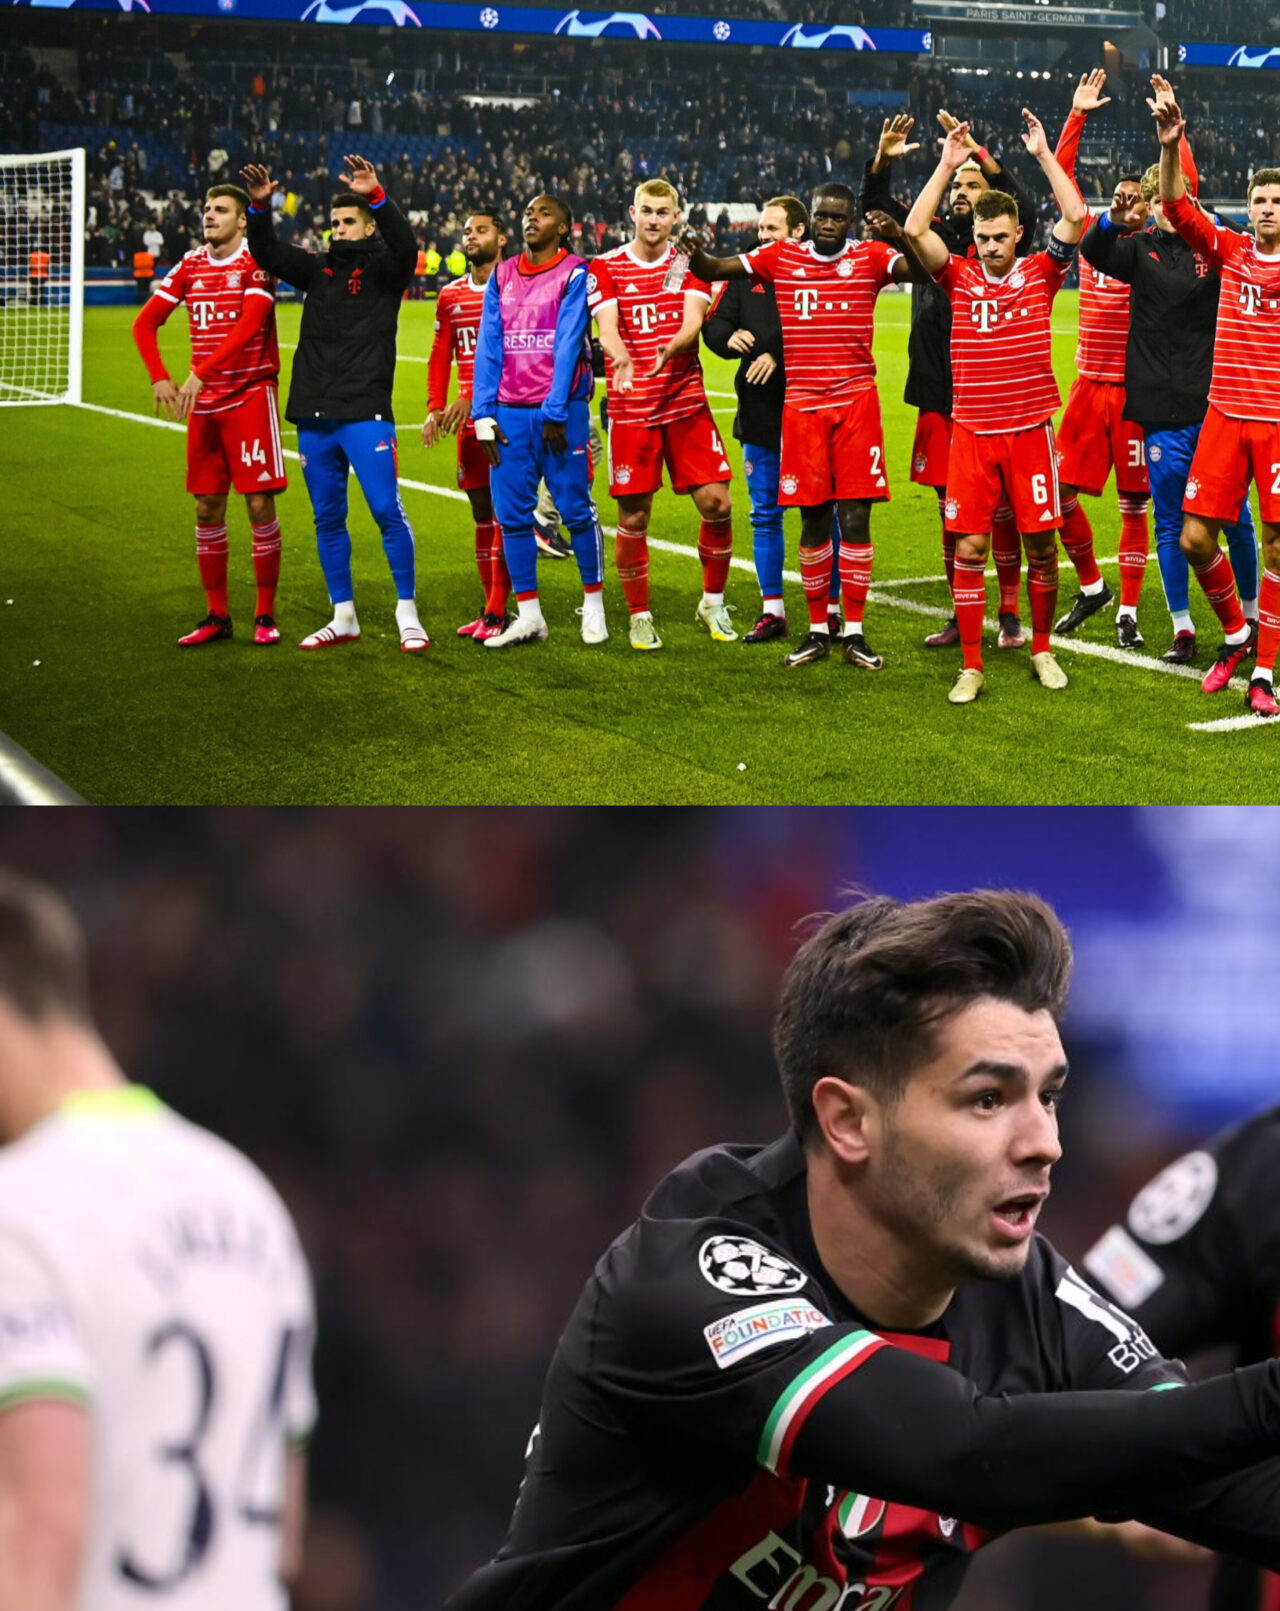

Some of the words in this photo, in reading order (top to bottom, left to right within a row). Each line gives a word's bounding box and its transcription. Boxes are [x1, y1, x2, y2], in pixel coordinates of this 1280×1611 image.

[966, 8, 999, 19] PARIS
[1001, 10, 1085, 23] SAINT-GERMAIN
[504, 334, 555, 349] RESPEC
[241, 438, 266, 468] 44
[712, 429, 724, 456] 4
[870, 446, 881, 475] 2
[1032, 473, 1048, 505] 6
[708, 1317, 737, 1338] UEFA
[711, 1308, 824, 1354] FOUNDATIO
